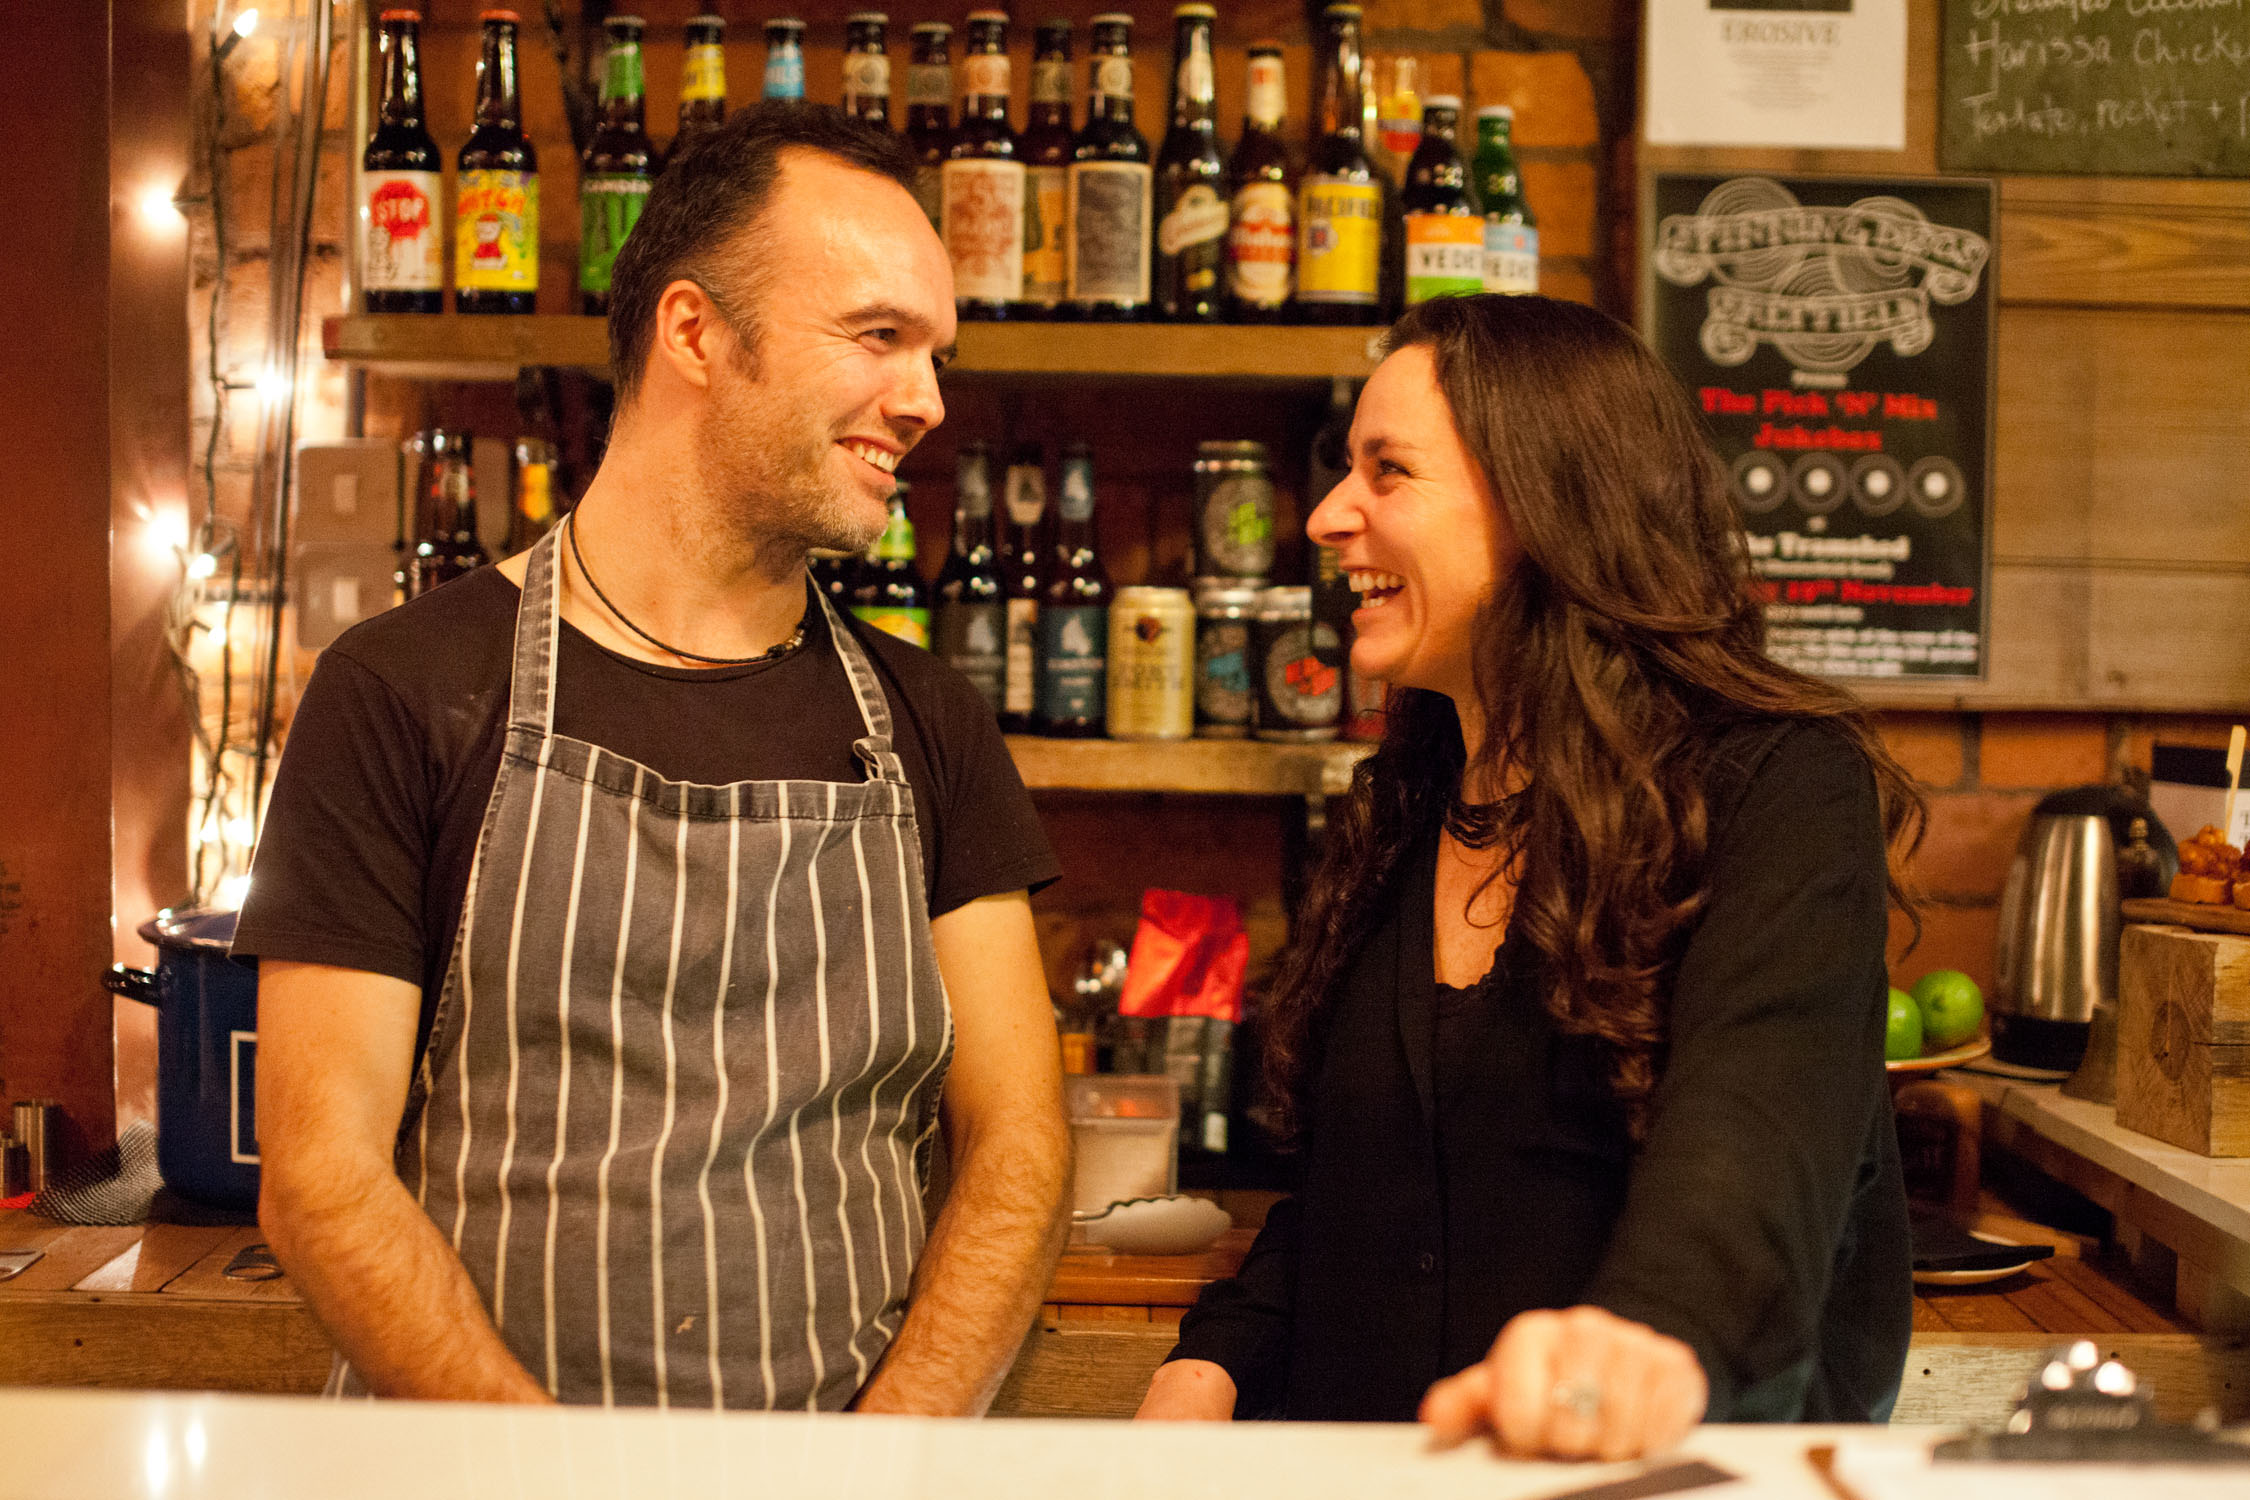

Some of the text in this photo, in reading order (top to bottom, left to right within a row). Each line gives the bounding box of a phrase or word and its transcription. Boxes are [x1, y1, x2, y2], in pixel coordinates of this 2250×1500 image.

[376, 197, 424, 224] STOP
[1700, 387, 1756, 414] The
[1762, 389, 1829, 417] Pick
[1884, 393, 1938, 420] Mix
[1753, 422, 1882, 450] Jukebox
[1841, 580, 1974, 607] November
